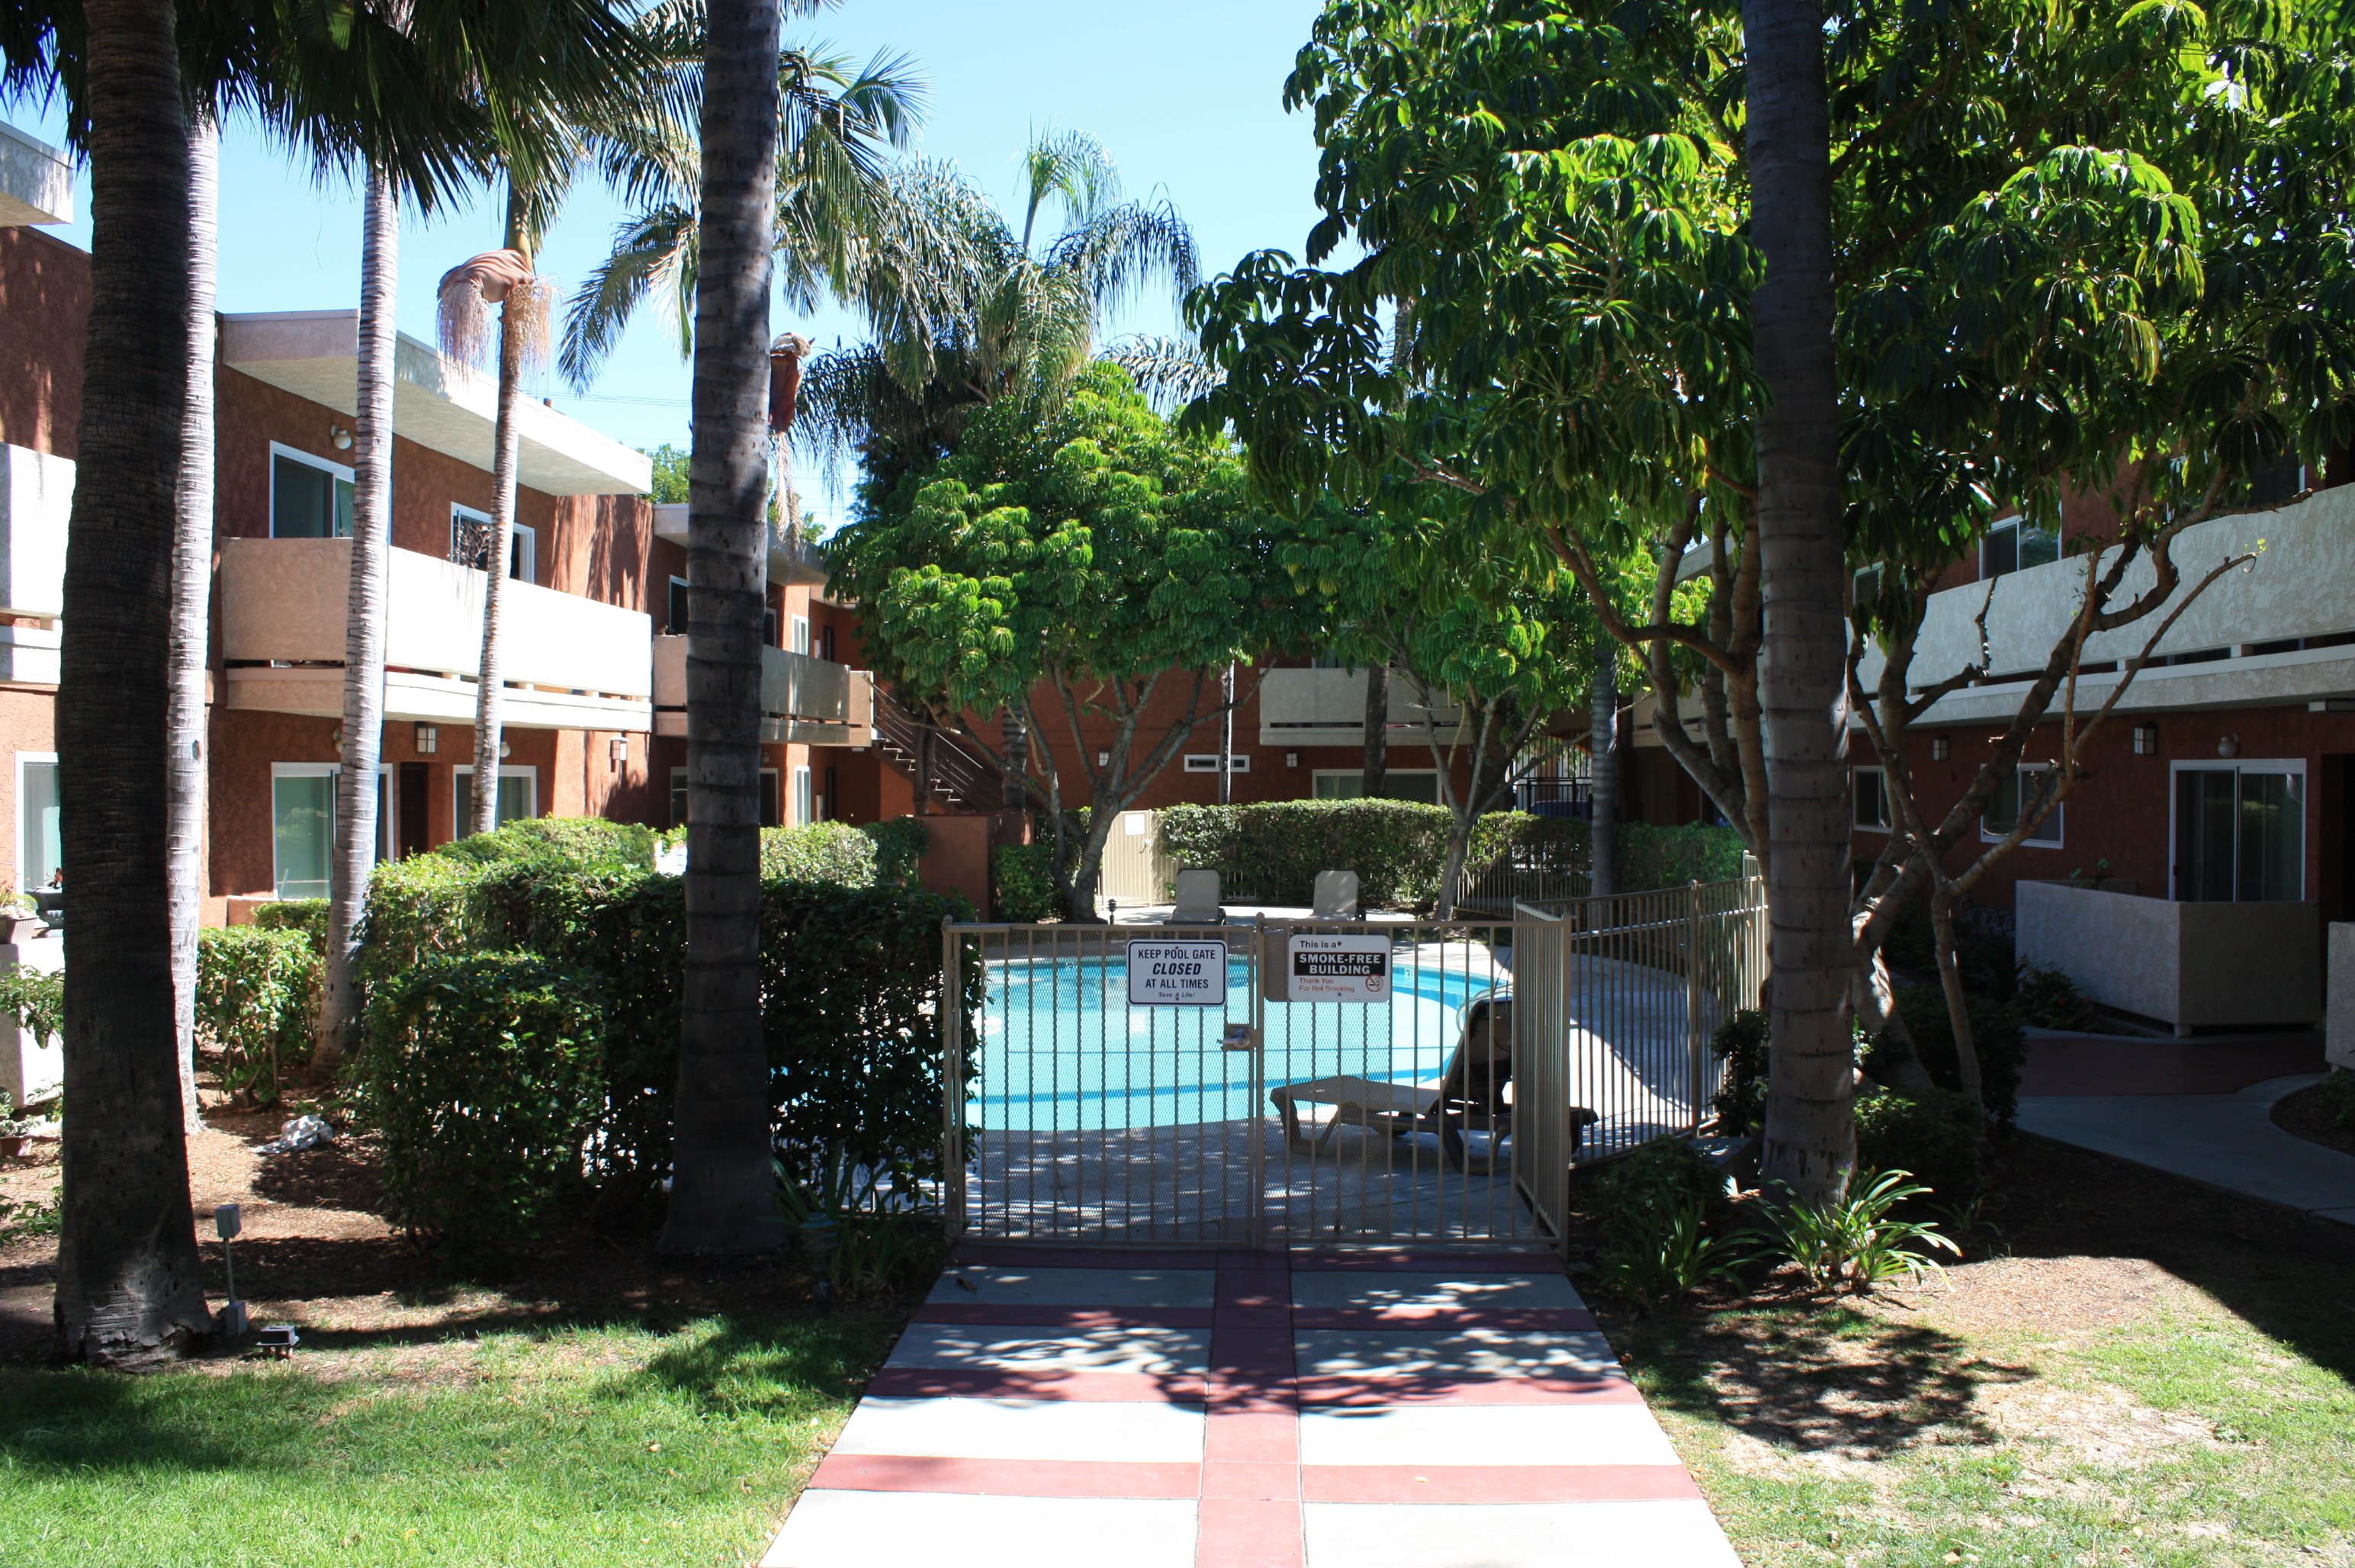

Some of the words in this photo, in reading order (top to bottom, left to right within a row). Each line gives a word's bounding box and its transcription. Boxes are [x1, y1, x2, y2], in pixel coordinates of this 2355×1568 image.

[1139, 949, 1161, 959] KEEP
[1165, 949, 1189, 959] POOL
[1193, 949, 1215, 959] GATE
[1300, 954, 1380, 963] SMOKE-FREE
[1153, 962, 1201, 975] CLOSED
[1309, 965, 1370, 975] BUILDING
[1145, 979, 1156, 988] AT
[1160, 979, 1177, 988] ALL
[1181, 979, 1208, 988] TIMES
